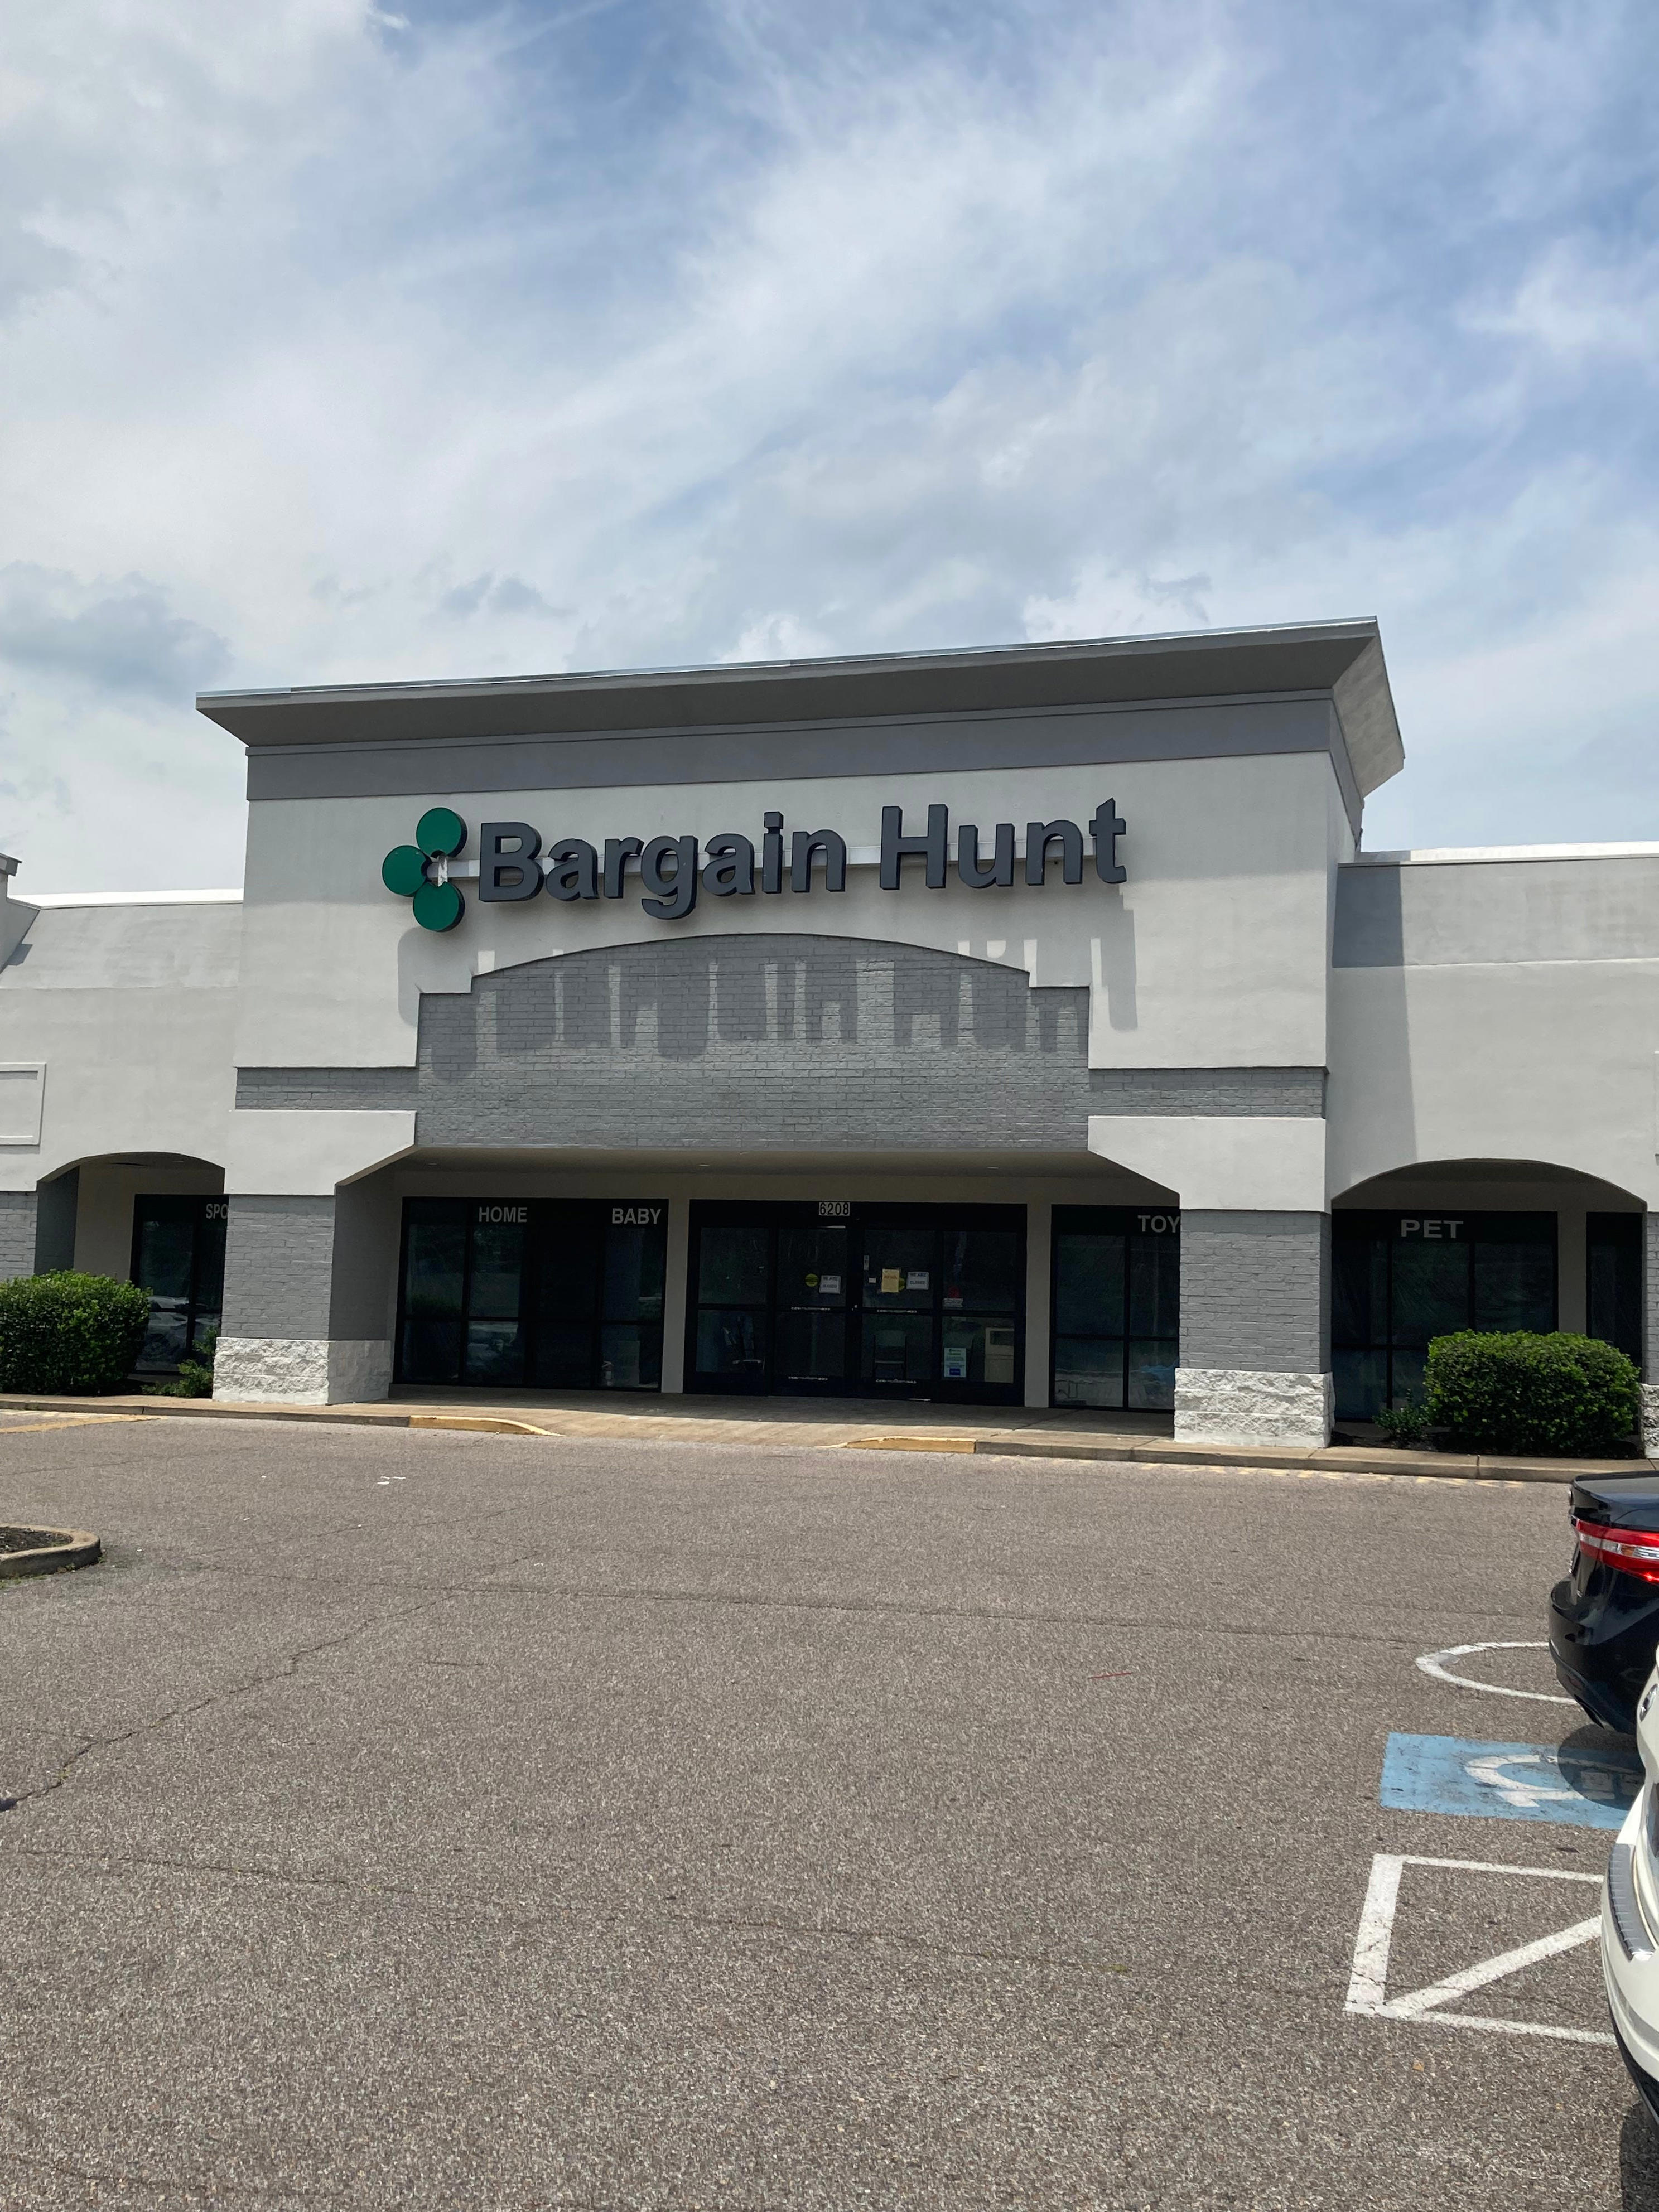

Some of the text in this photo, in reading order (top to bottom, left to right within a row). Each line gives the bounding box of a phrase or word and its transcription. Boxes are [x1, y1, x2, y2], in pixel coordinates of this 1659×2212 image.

[478, 797, 1127, 920] Bargain Hunt
[206, 1204, 228, 1219] SPO
[479, 1206, 527, 1223] HOME
[612, 1208, 662, 1224] BABY
[820, 1202, 848, 1215] 6208
[1137, 1215, 1181, 1233] TOY
[1401, 1219, 1464, 1238] PET
